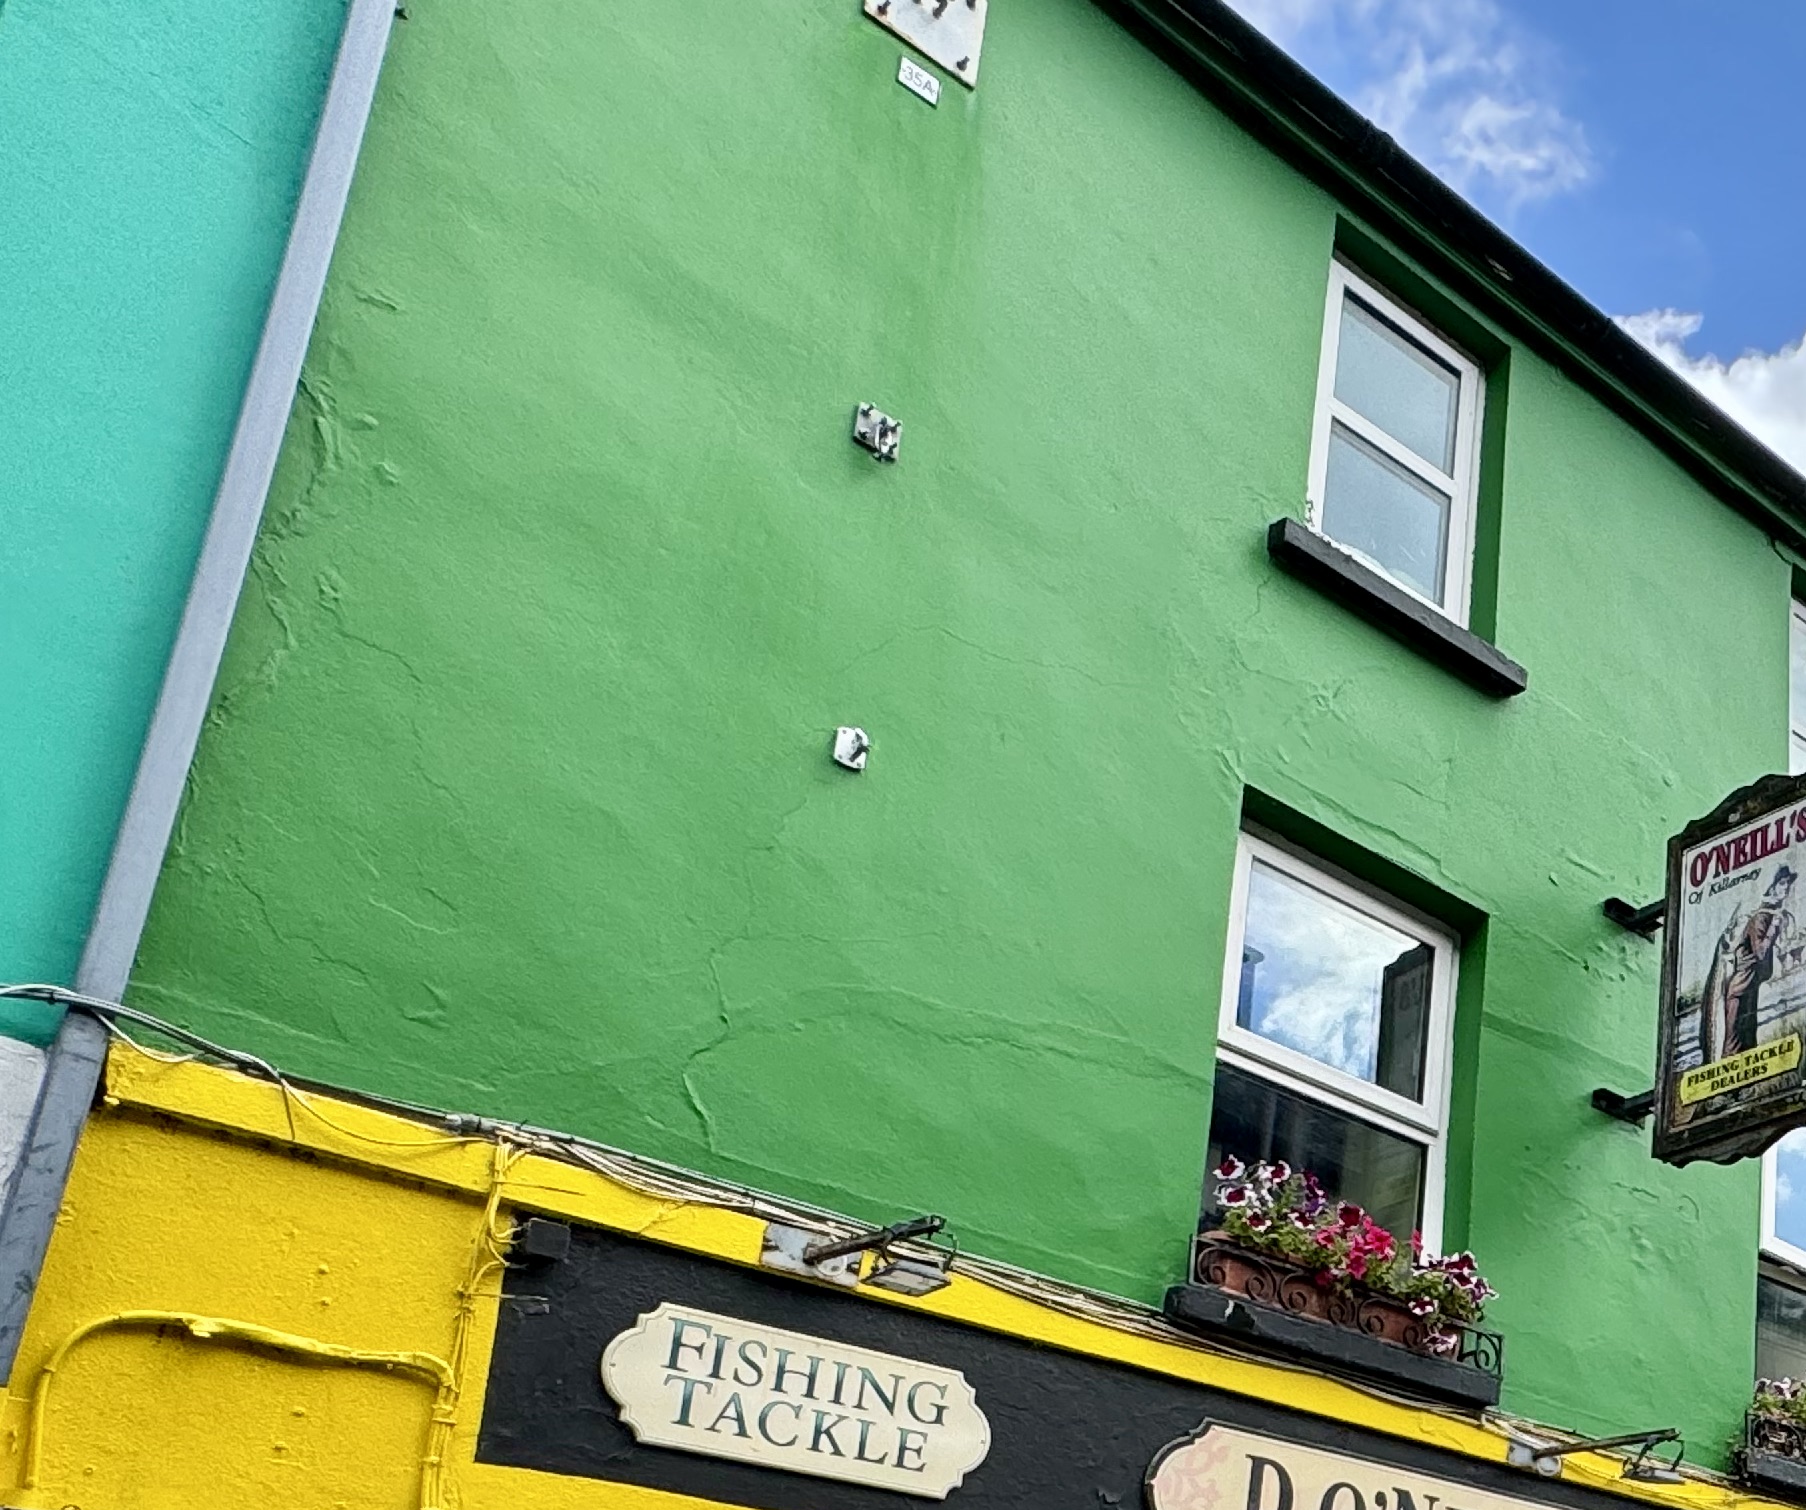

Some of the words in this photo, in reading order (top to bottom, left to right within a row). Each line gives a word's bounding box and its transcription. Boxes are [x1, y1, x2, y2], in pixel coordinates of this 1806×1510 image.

[1687, 888, 1705, 906] Of
[1686, 1059, 1741, 1088] FISHING
[1744, 1038, 1796, 1067] TACKLE
[1709, 1062, 1769, 1093] DEALERS
[660, 1315, 951, 1428] FISHING
[663, 1373, 929, 1473] TACKLE
